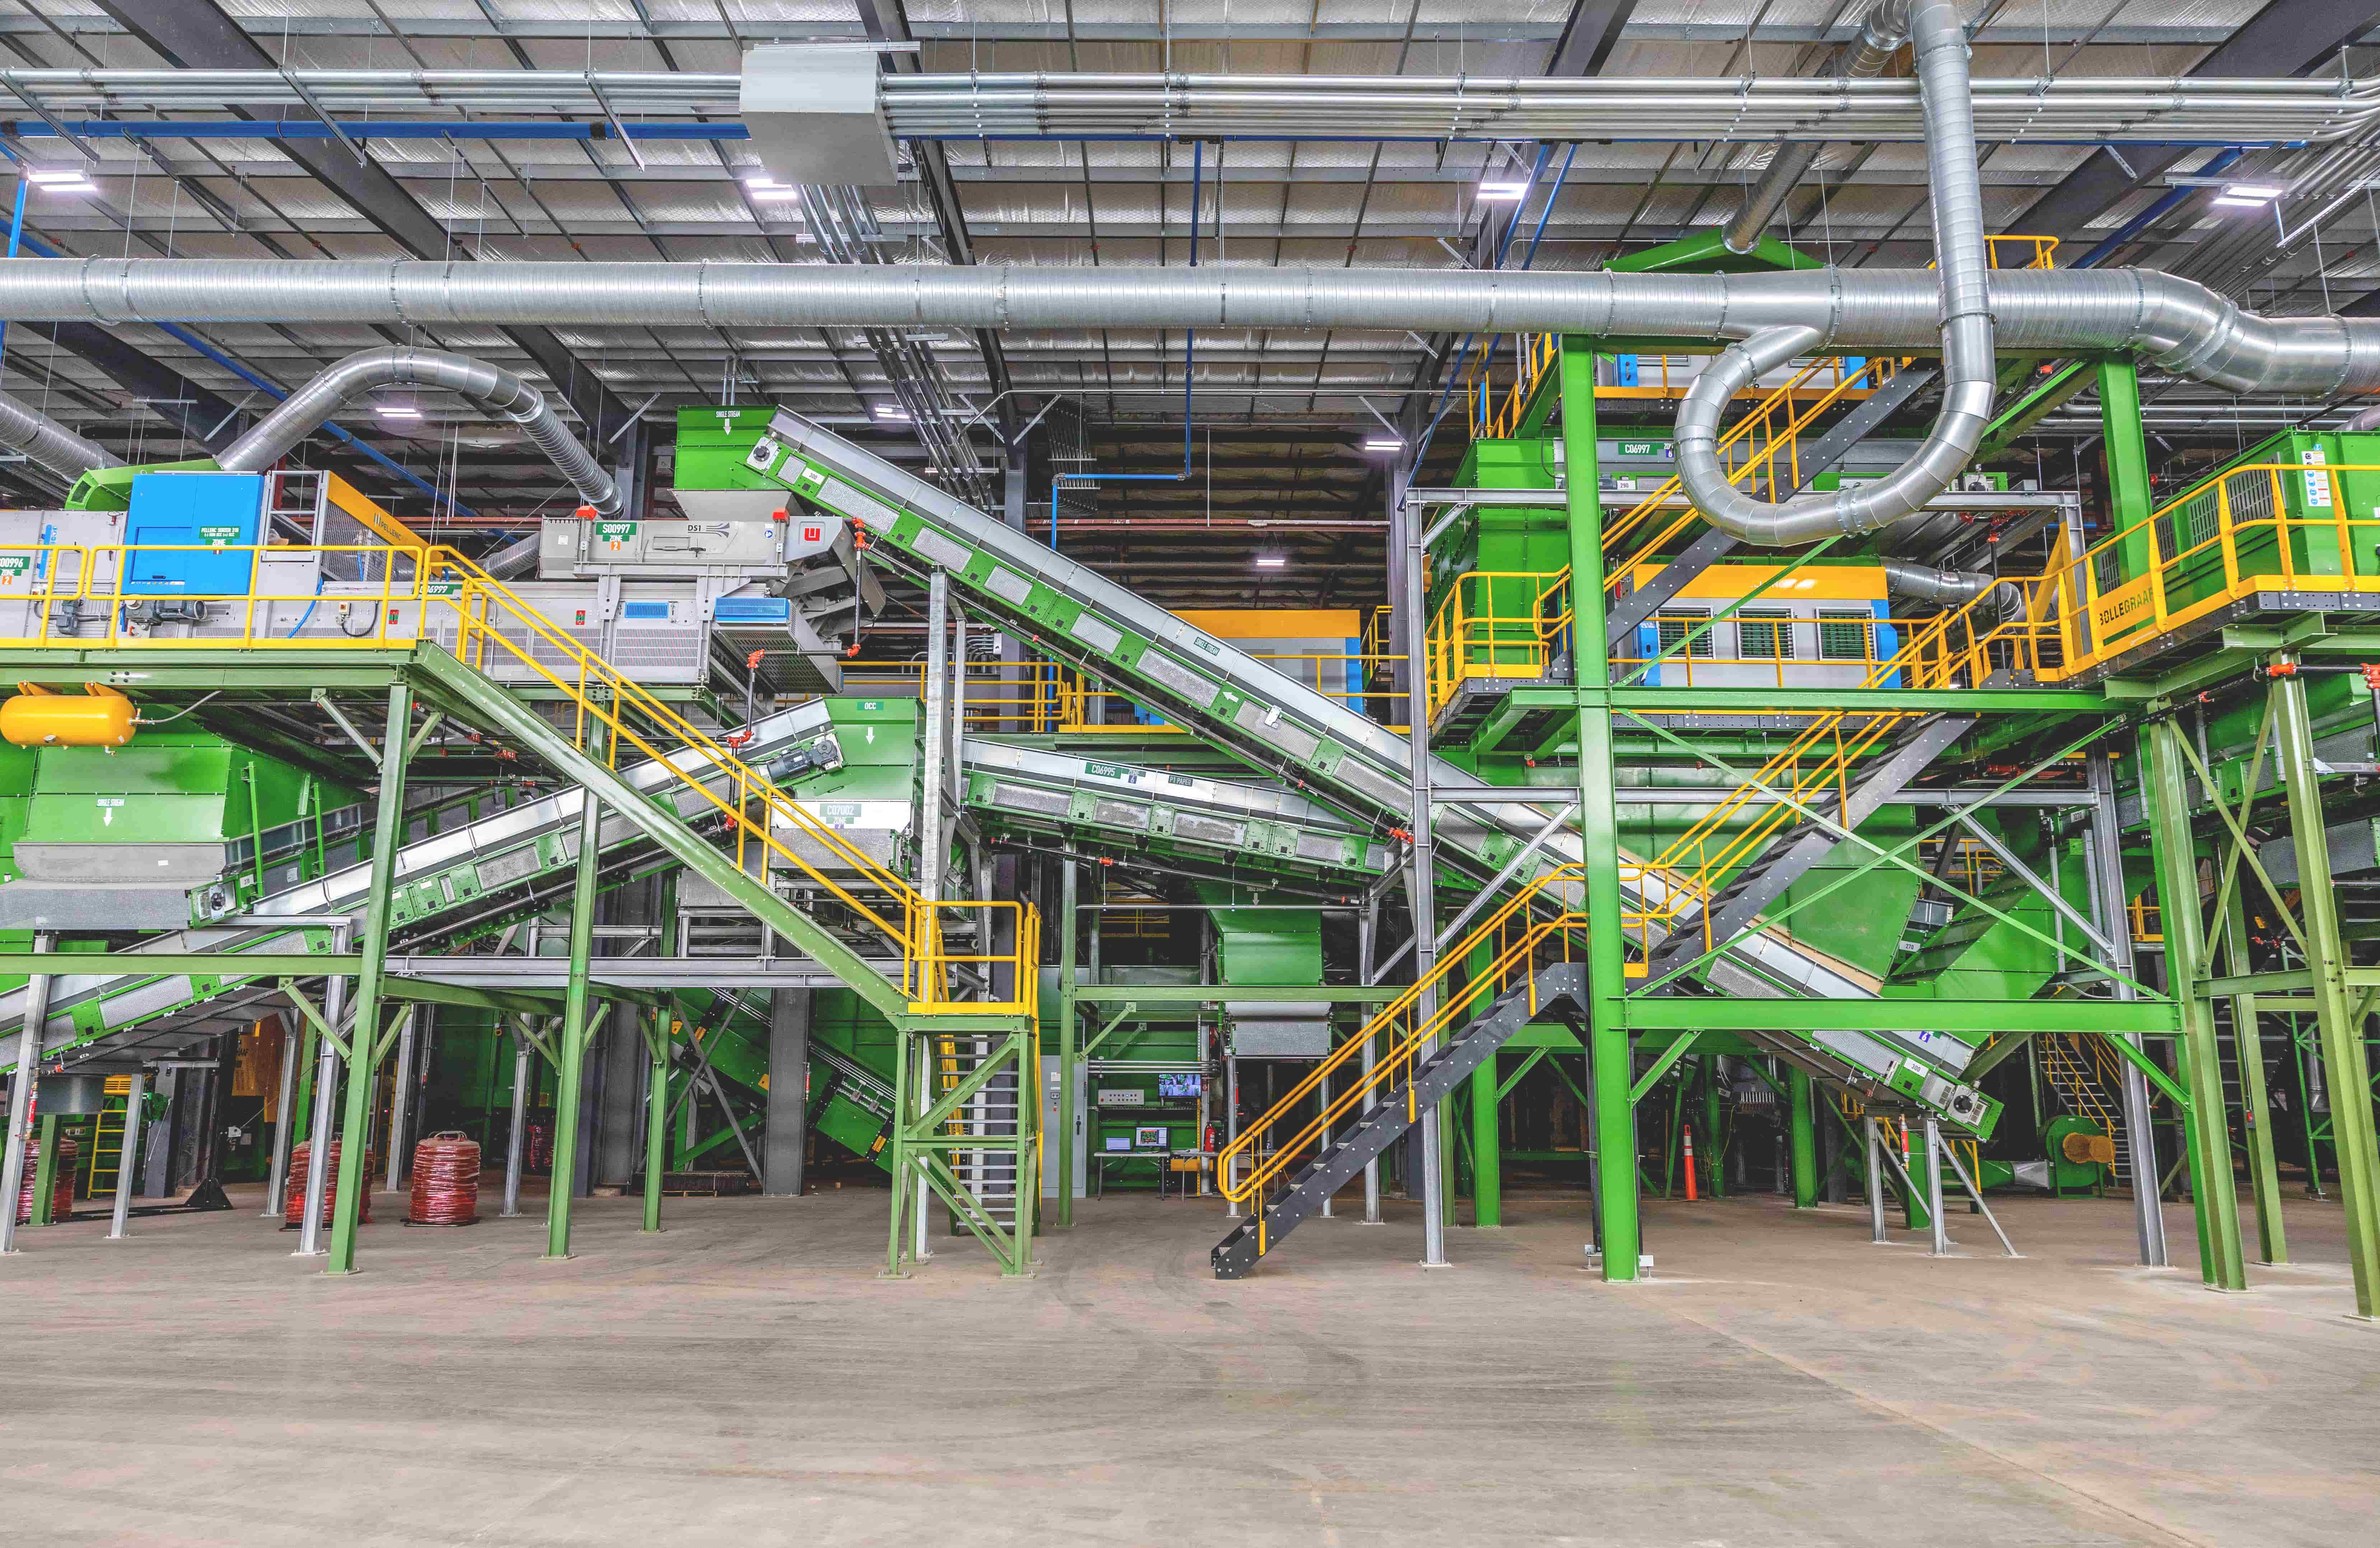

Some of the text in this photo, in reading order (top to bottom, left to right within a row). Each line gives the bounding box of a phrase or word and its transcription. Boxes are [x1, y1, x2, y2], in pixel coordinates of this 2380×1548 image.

[381, 522, 402, 541] PELLENC
[0, 558, 23, 568] 00996
[1195, 638, 1219, 655] SINGLE STREAM
[1921, 1033, 1928, 1041] 6
